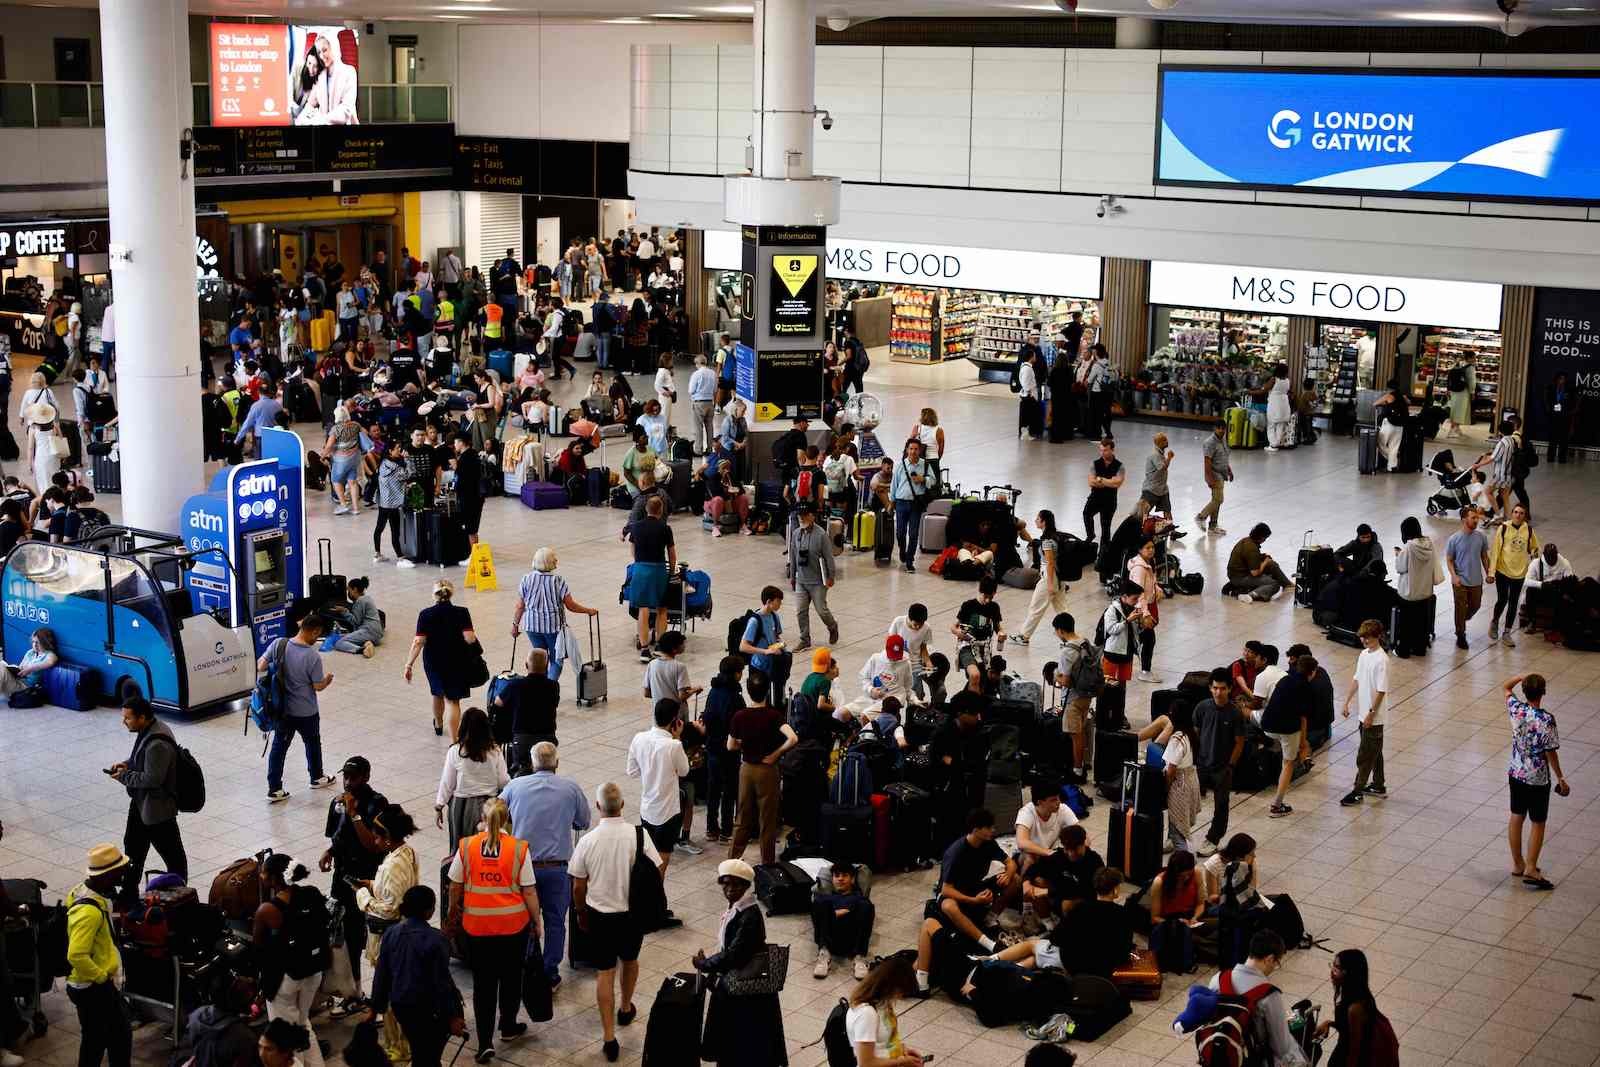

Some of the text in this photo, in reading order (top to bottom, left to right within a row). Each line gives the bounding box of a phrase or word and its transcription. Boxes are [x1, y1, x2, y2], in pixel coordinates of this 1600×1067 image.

[232, 34, 252, 46] back
[253, 34, 269, 46] and
[242, 51, 278, 62] non-stop
[220, 61, 263, 72] to London
[1313, 111, 1414, 131] LONDON
[483, 142, 499, 153] Exit
[1311, 132, 1413, 153] GATWICK
[483, 158, 504, 169] Taxis
[483, 173, 523, 186] Car rental
[15, 229, 65, 255] COFFEE
[778, 231, 817, 240] Information
[885, 251, 961, 278] FOOD
[1232, 276, 1406, 312] M&S FOOD
[1545, 318, 1591, 330] THIS IS
[1544, 331, 1572, 343] NOT
[1543, 344, 1591, 358] FOOD...
[238, 473, 276, 497] atm
[190, 509, 223, 533] atm
[193, 659, 221, 672] LONDON
[480, 872, 503, 882] TCO
